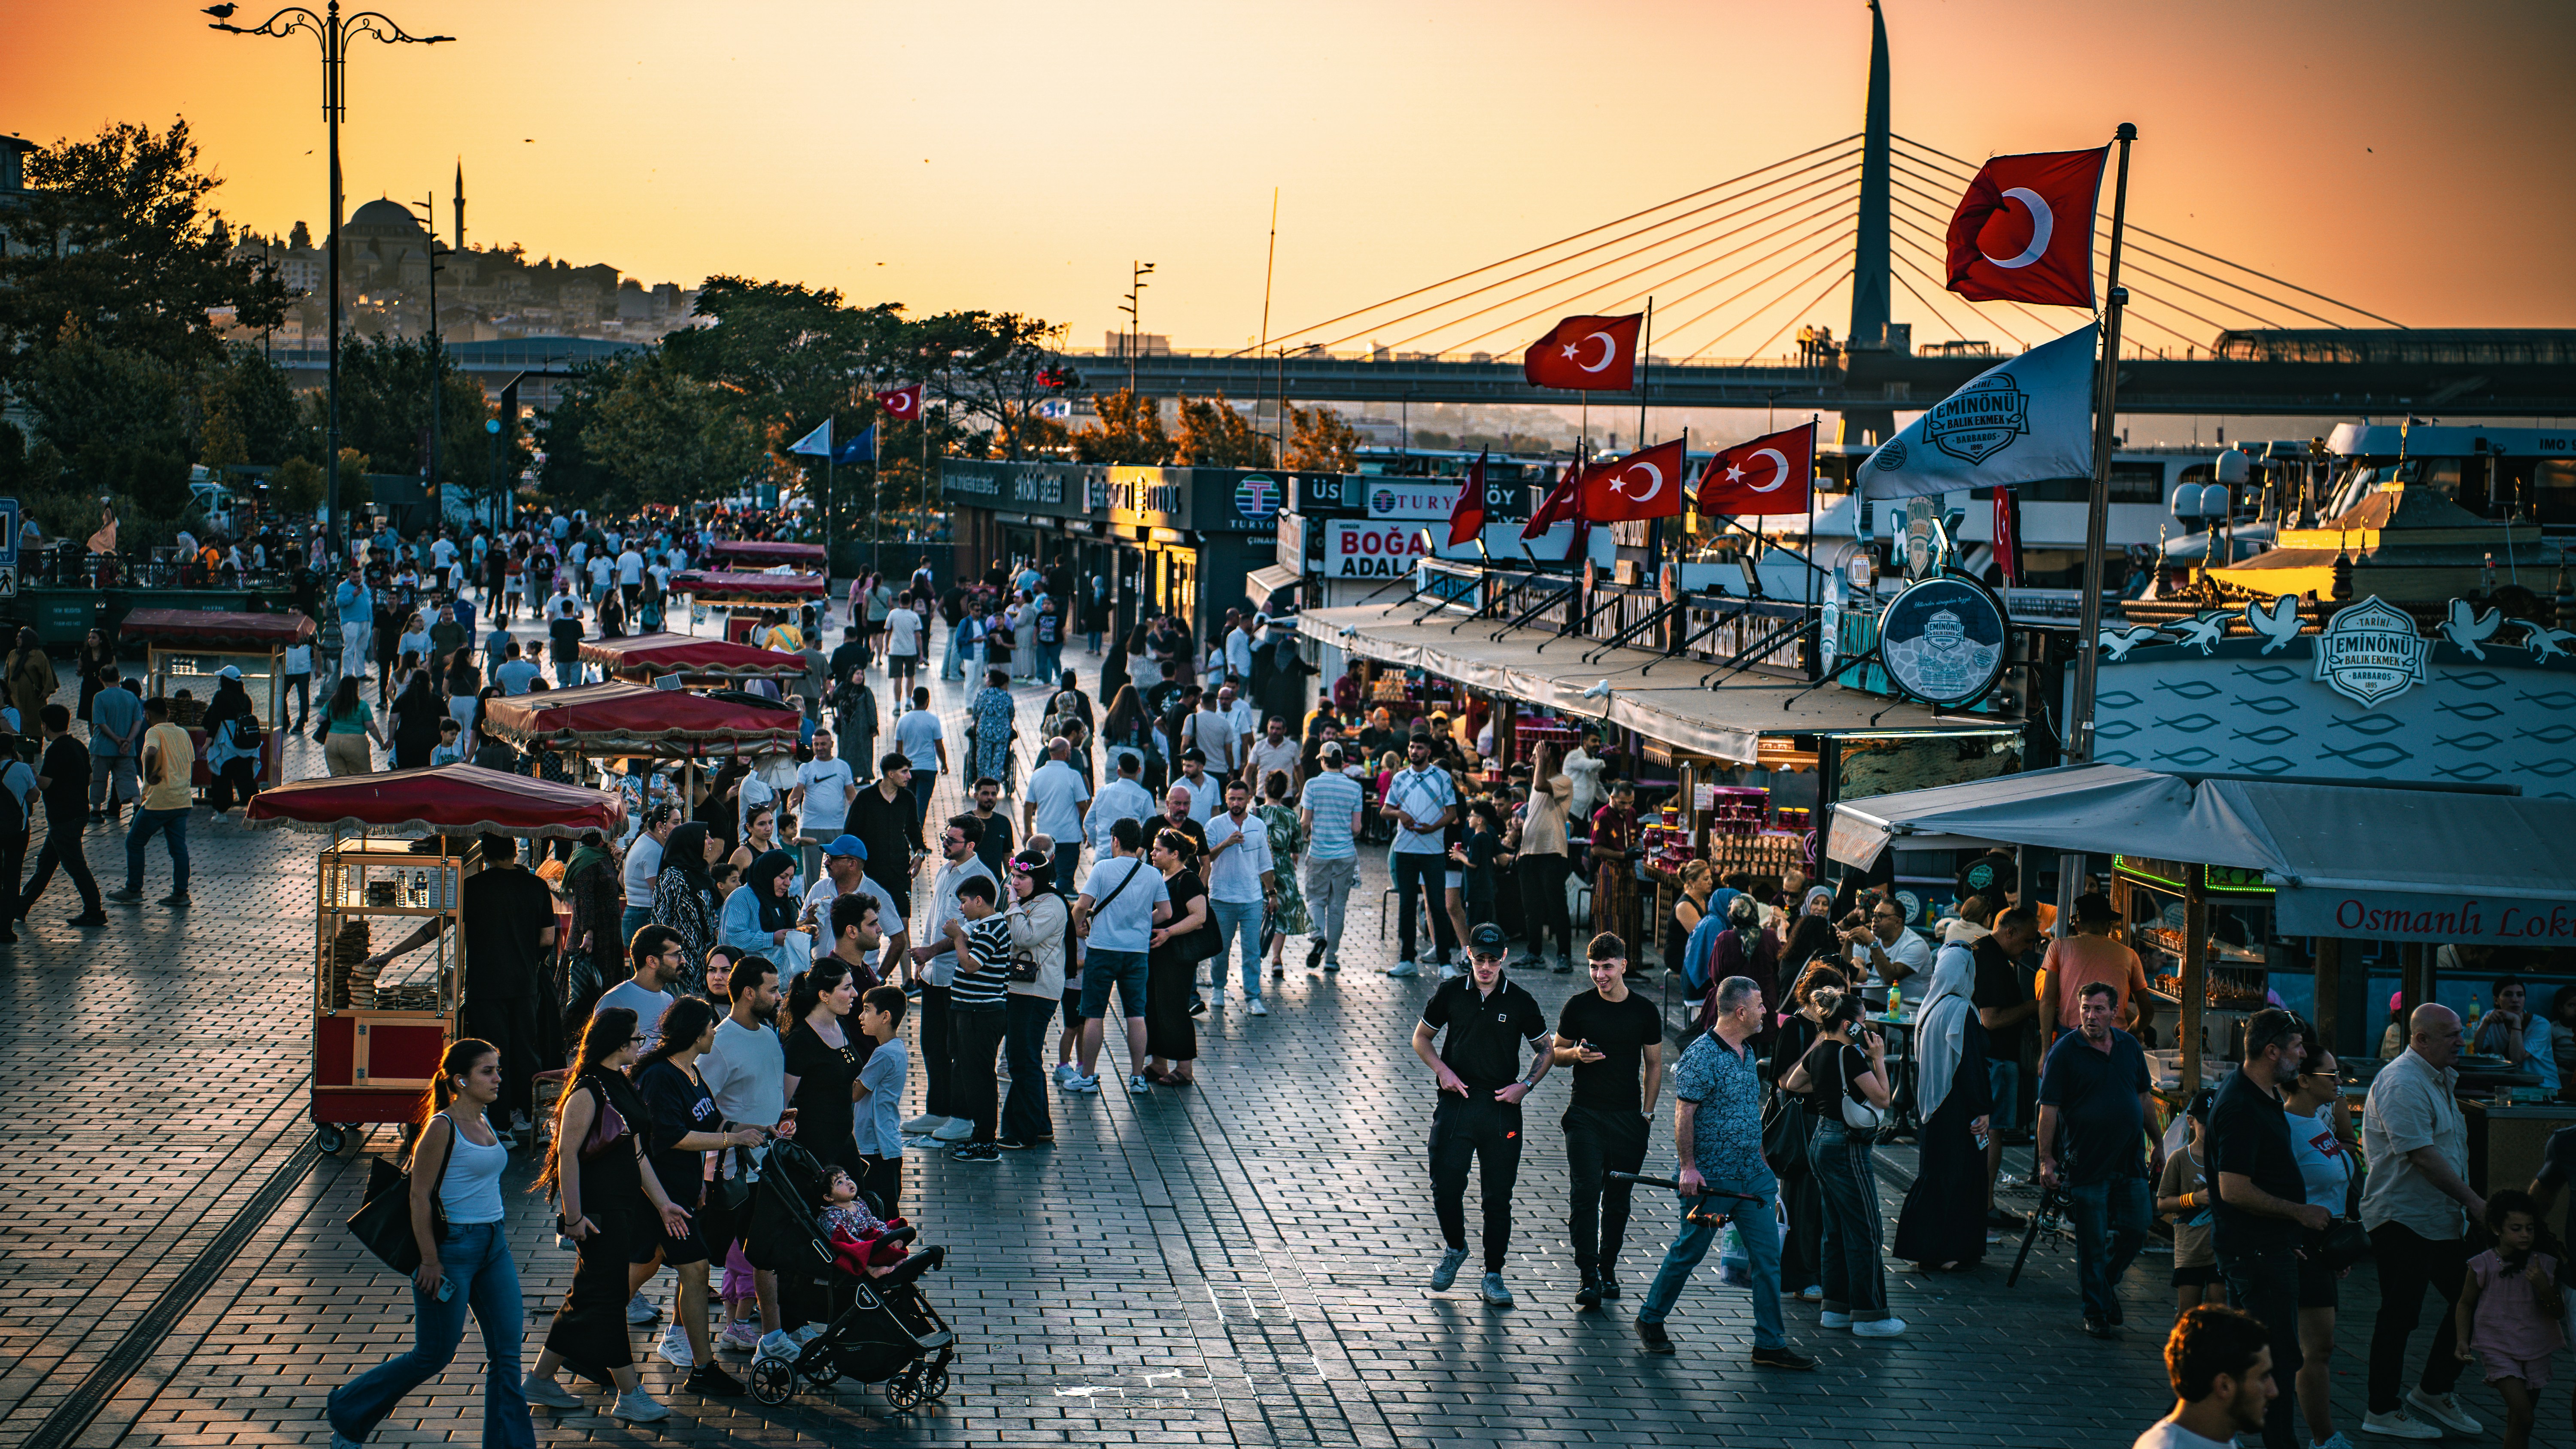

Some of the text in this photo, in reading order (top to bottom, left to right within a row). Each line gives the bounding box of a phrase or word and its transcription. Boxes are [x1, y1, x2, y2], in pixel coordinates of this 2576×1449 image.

[1937, 392, 2015, 418] EMİNÖNÜ
[1947, 415, 2005, 429] BALIK EKMEK
[1956, 434, 1996, 444] BARBAROS
[2540, 438, 2566, 450] IMO
[1313, 479, 1342, 499] ÜS
[1486, 484, 1516, 505] ÖY
[1929, 622, 1959, 631] EMİNÖNÜ
[2359, 616, 2391, 627] TARİHİ
[2336, 632, 2411, 655] EMİNÖNÜ
[2345, 655, 2400, 666] BALIK EKMEK
[2352, 672, 2391, 680] BARBAROS
[2336, 900, 2576, 938] Osmanlı Lok
